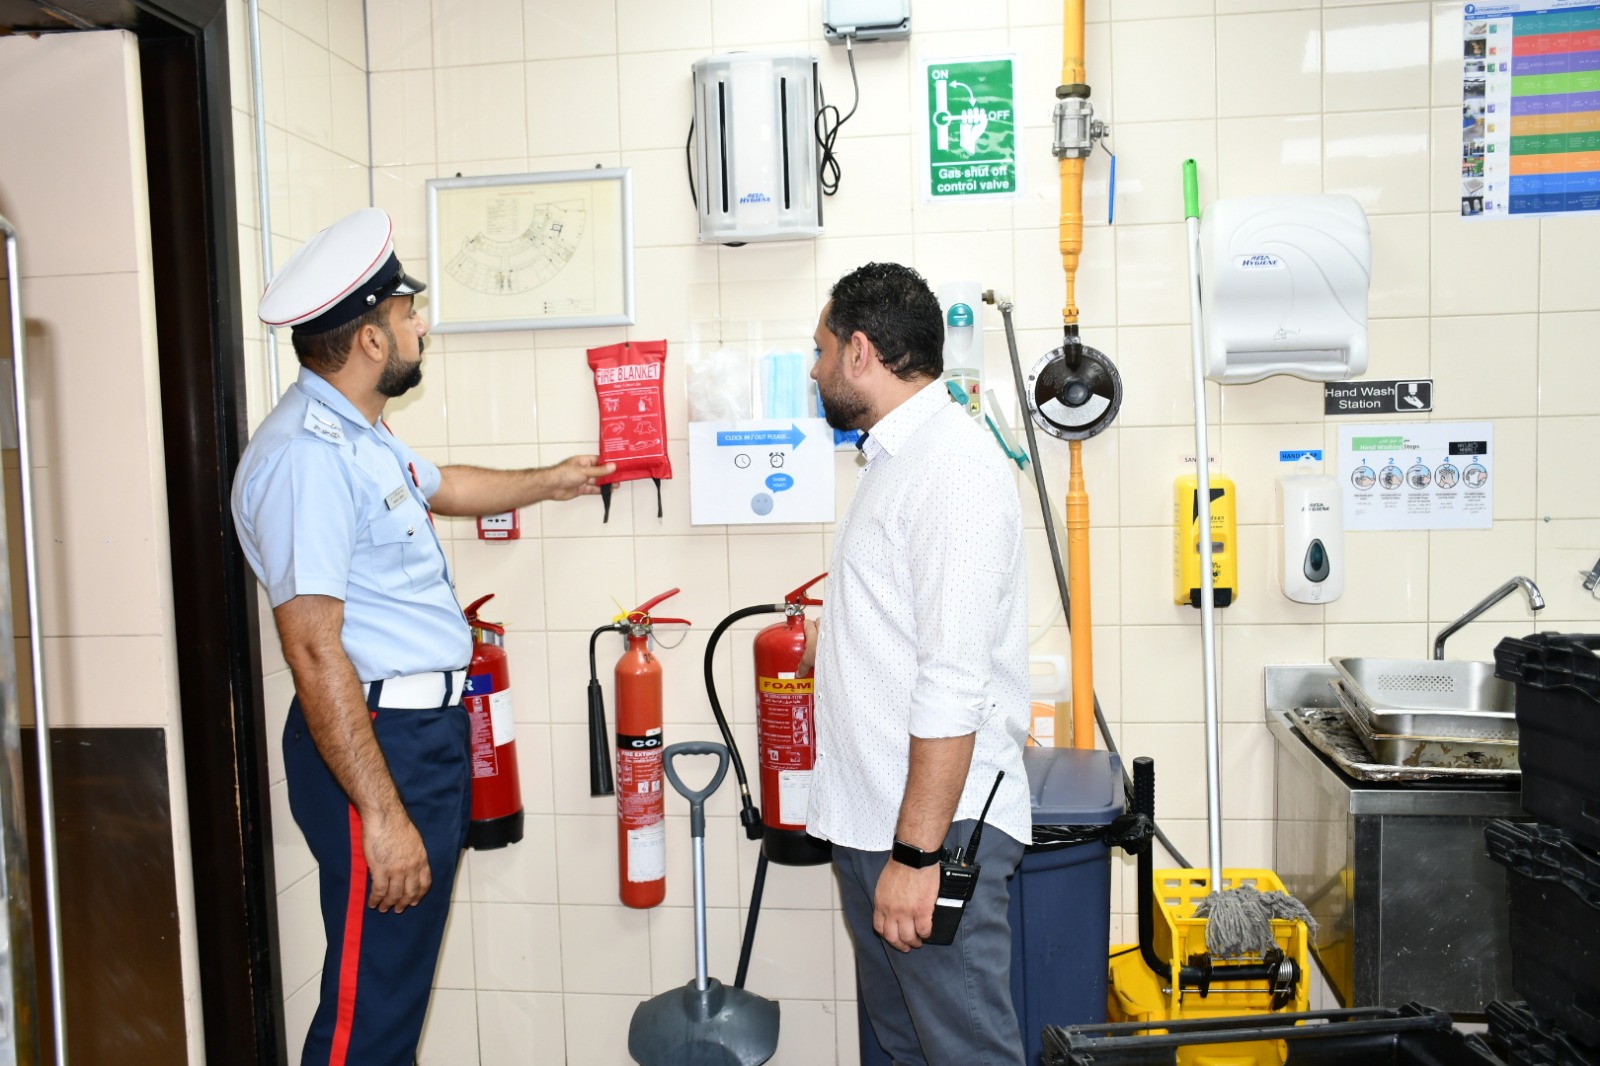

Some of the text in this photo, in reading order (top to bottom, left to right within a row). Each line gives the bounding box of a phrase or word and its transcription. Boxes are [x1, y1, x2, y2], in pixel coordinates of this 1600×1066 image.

[931, 70, 948, 79] ON
[988, 110, 1010, 120] OFF
[938, 165, 1008, 179] Gas shut off
[937, 179, 1010, 192] control valve
[596, 364, 658, 384] FIRE BLANKET
[1325, 386, 1395, 398] Hand Wash
[1339, 399, 1381, 409] Station
[1388, 457, 1394, 465] 2
[1416, 456, 1422, 464] 3
[763, 681, 811, 690] FOAM
